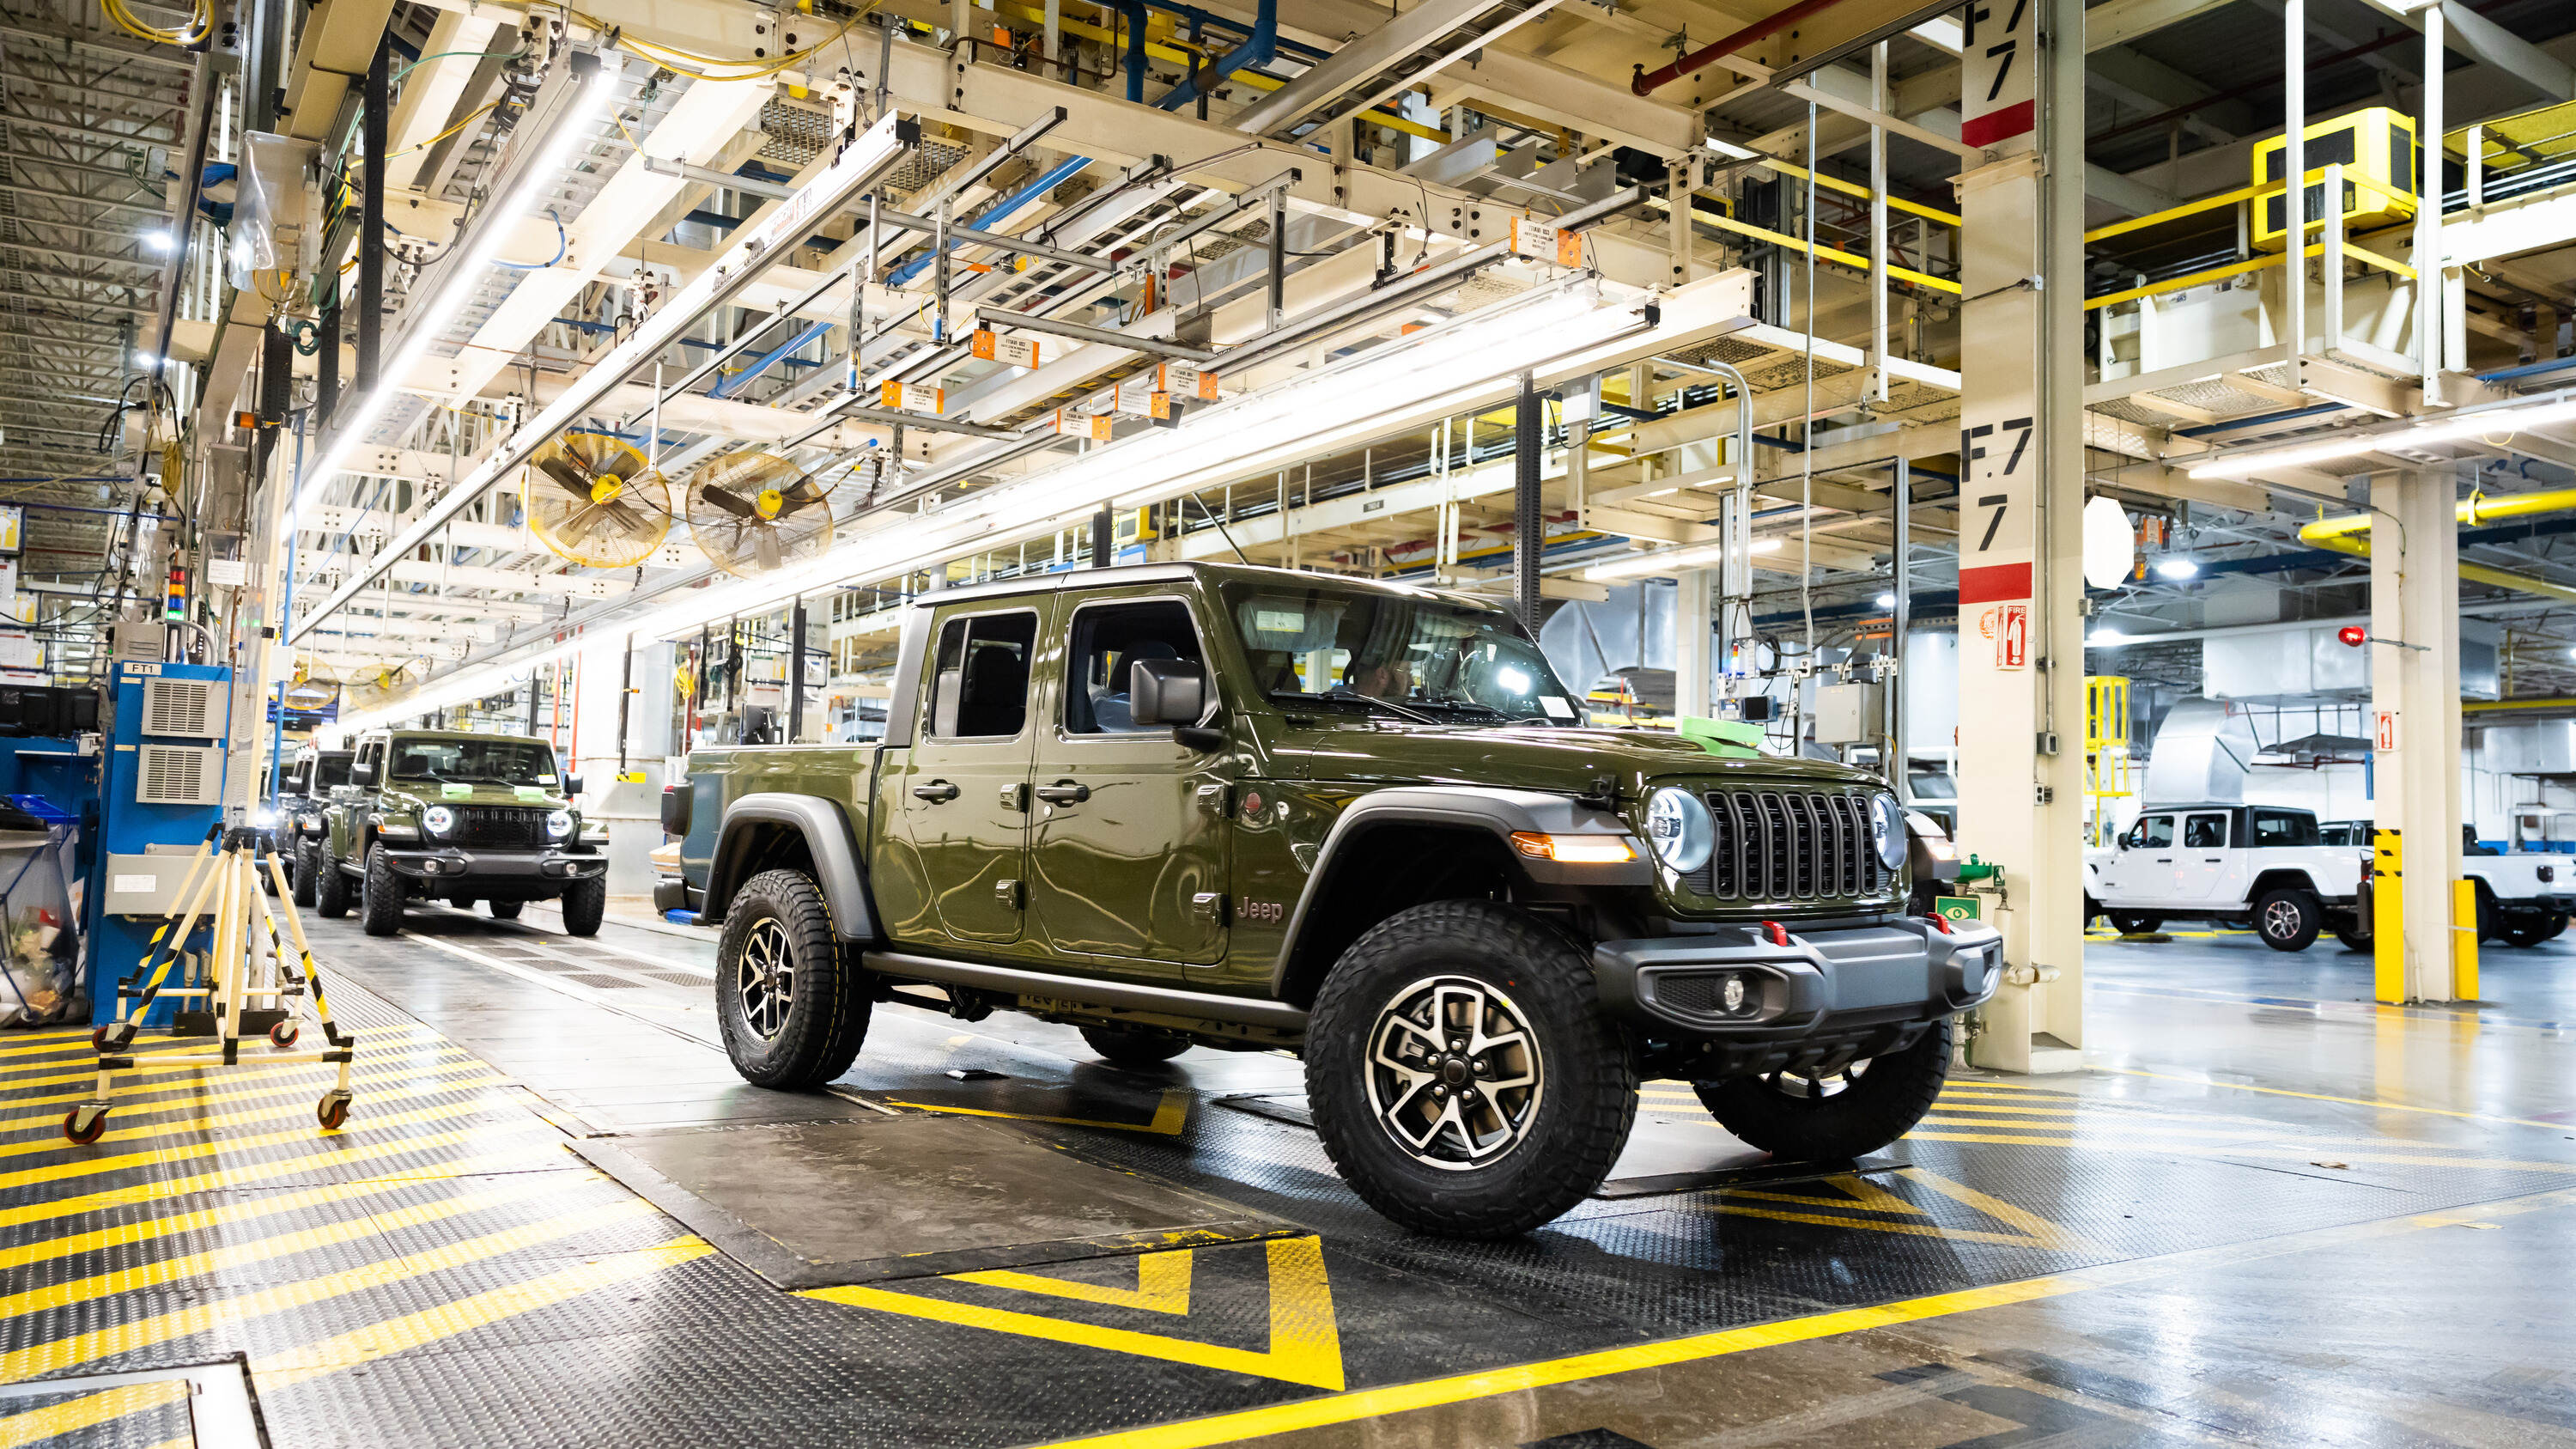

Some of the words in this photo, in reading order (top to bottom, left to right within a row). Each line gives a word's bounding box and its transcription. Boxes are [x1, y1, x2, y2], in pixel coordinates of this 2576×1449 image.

[1986, 39, 2016, 102] 7
[1978, 494, 2008, 551] 7
[131, 664, 153, 673] FT1
[1236, 896, 1284, 924] Jeep
